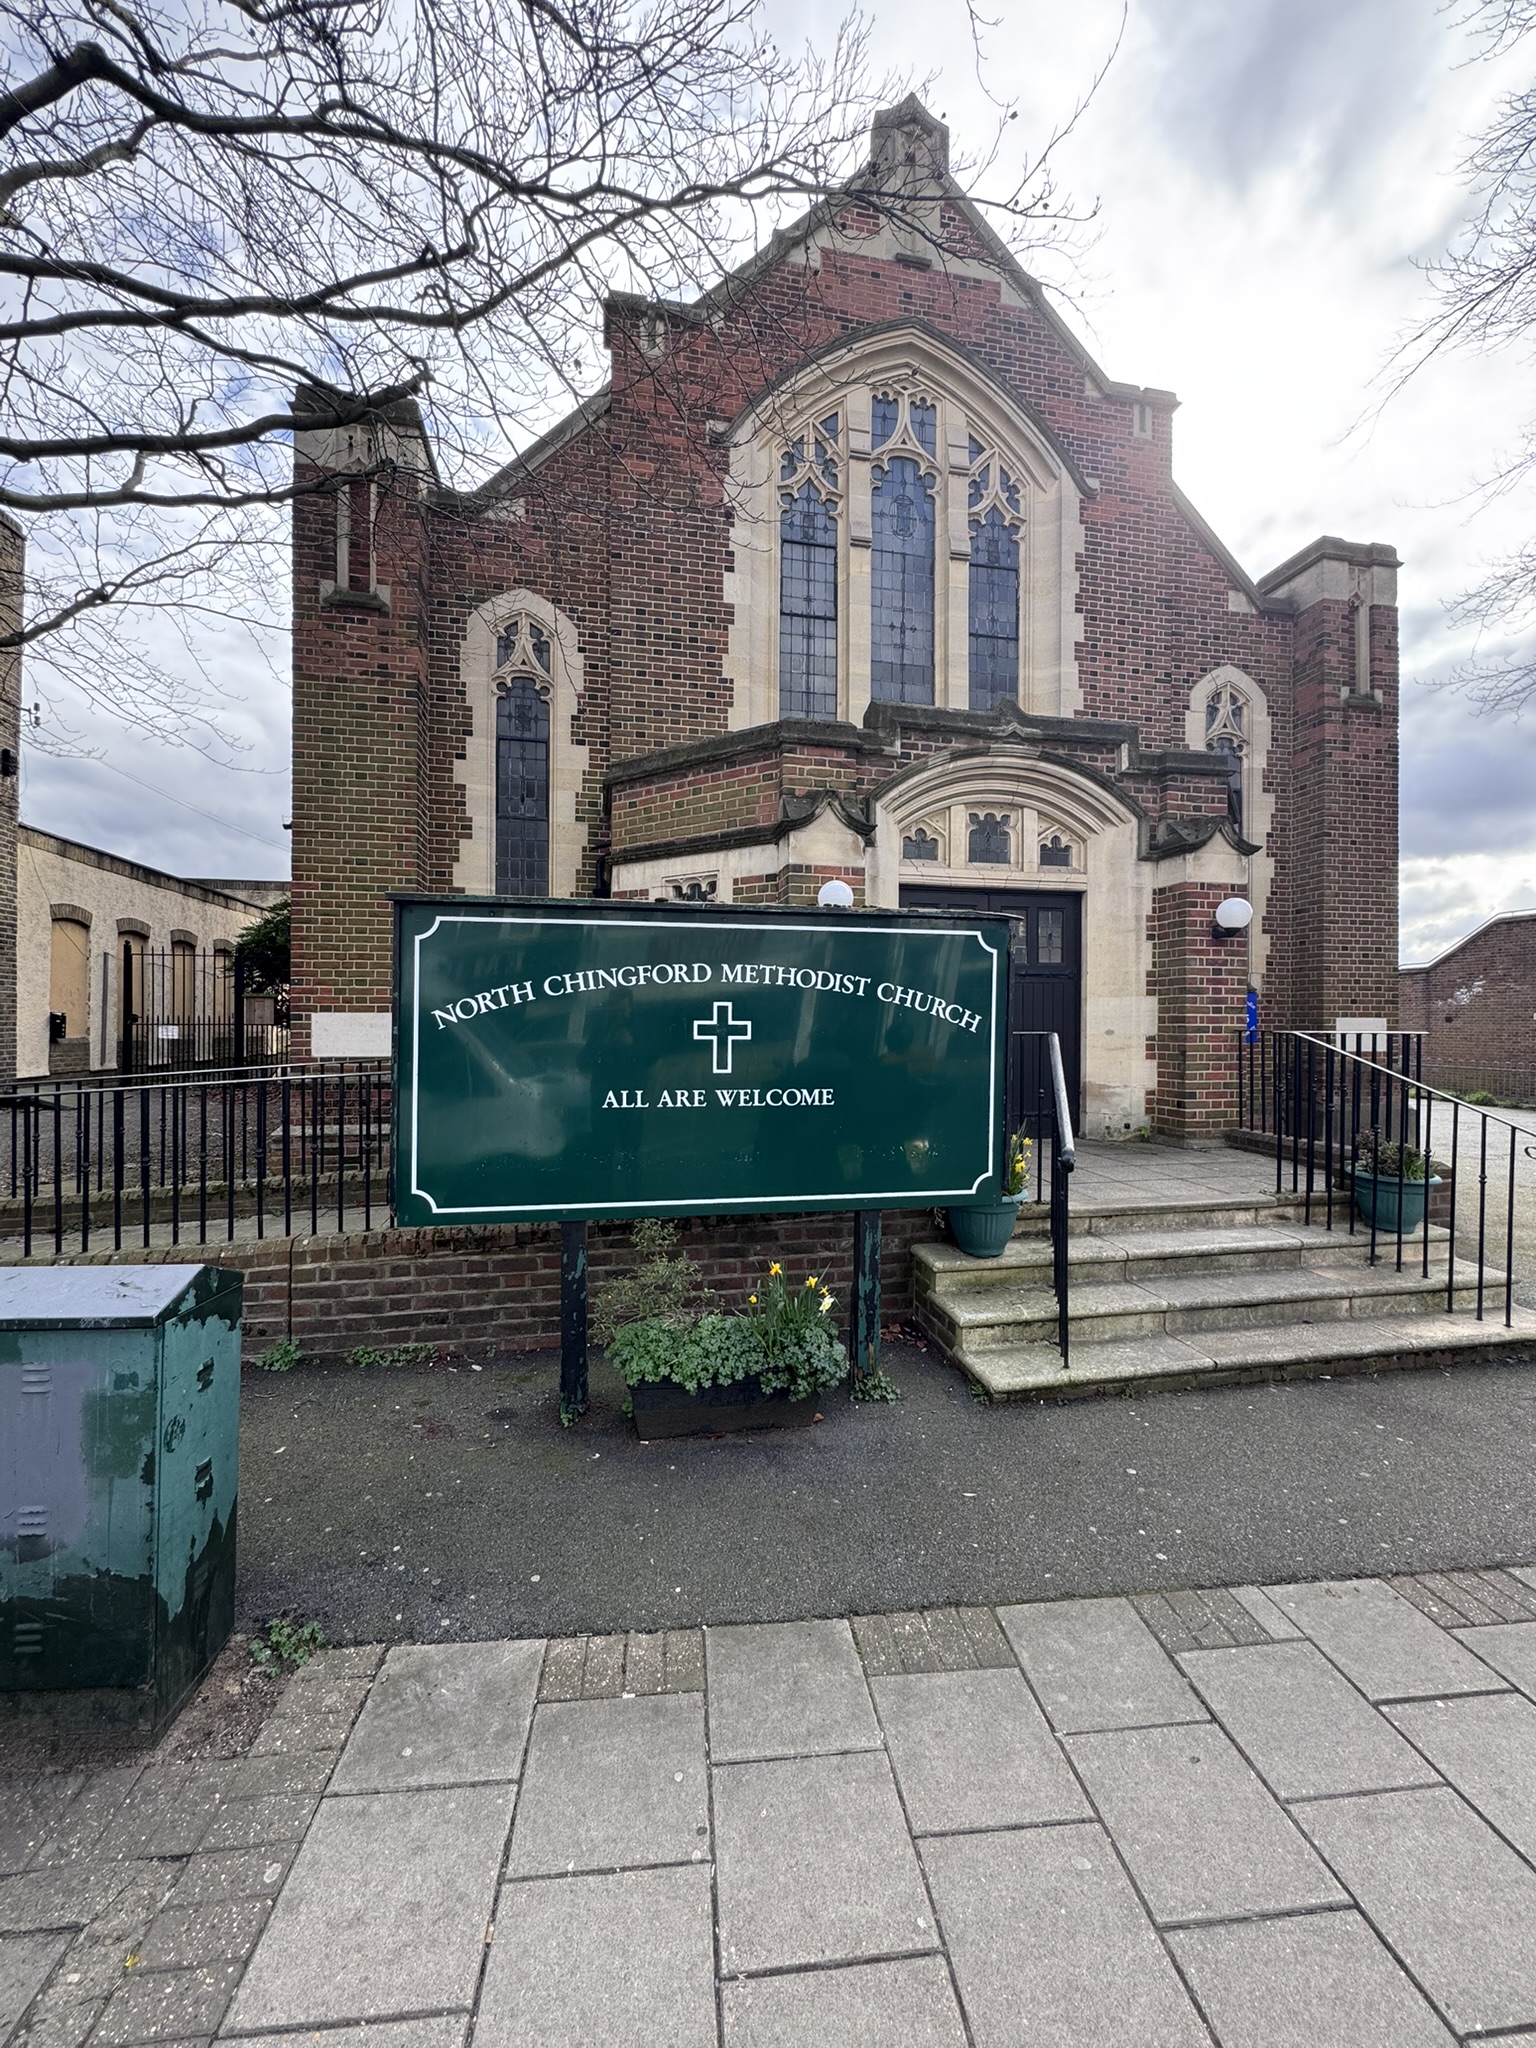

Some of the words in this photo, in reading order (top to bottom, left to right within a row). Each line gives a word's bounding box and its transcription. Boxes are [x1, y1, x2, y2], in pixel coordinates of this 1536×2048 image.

[430, 979, 536, 1031] NORTH
[543, 963, 712, 996] CHINGFORD
[720, 963, 872, 998] METHODIST
[877, 982, 983, 1034] CHURCH
[601, 1090, 650, 1109] ALL
[656, 1089, 707, 1108] ARE
[714, 1088, 835, 1107] WELCOME
